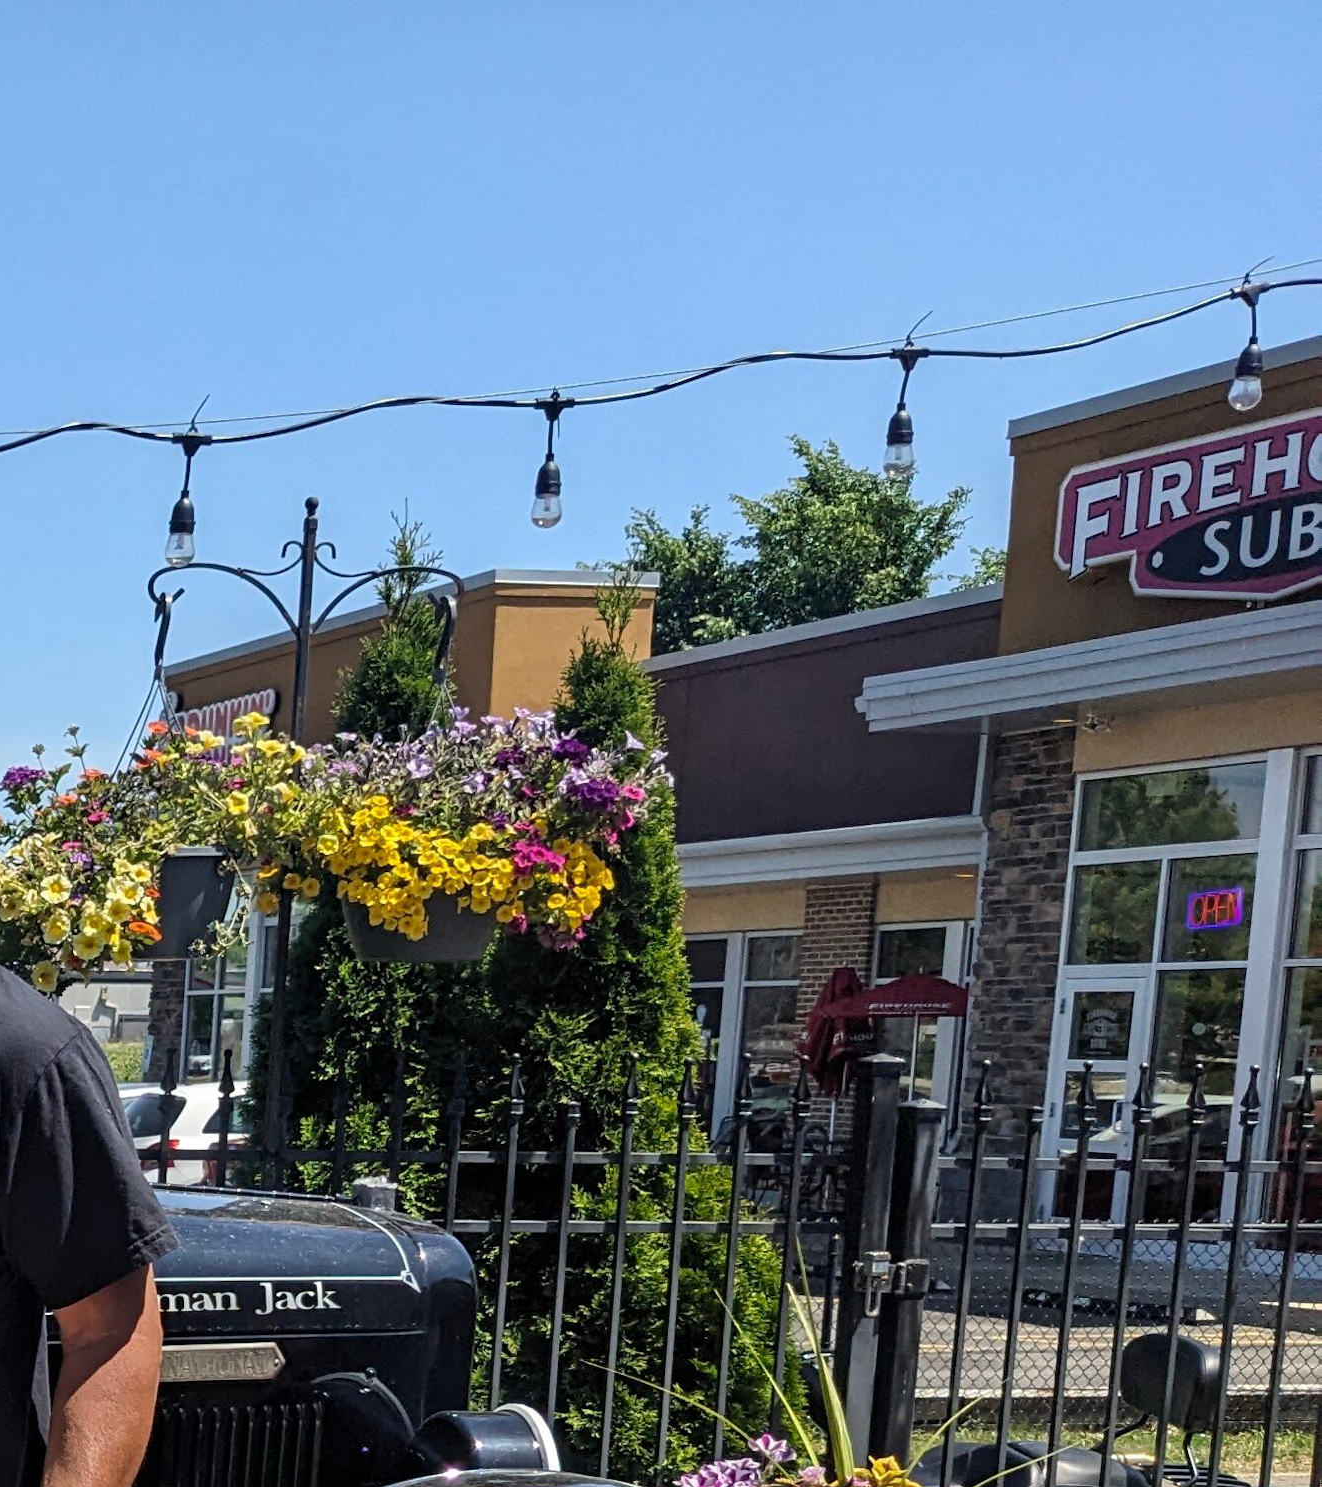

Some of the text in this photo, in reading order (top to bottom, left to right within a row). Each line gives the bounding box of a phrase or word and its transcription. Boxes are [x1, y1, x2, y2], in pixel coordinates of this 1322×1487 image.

[1191, 892, 1237, 925] OPEN
[157, 1281, 341, 1315] man Jack
[161, 1350, 271, 1378] NATIONAL
